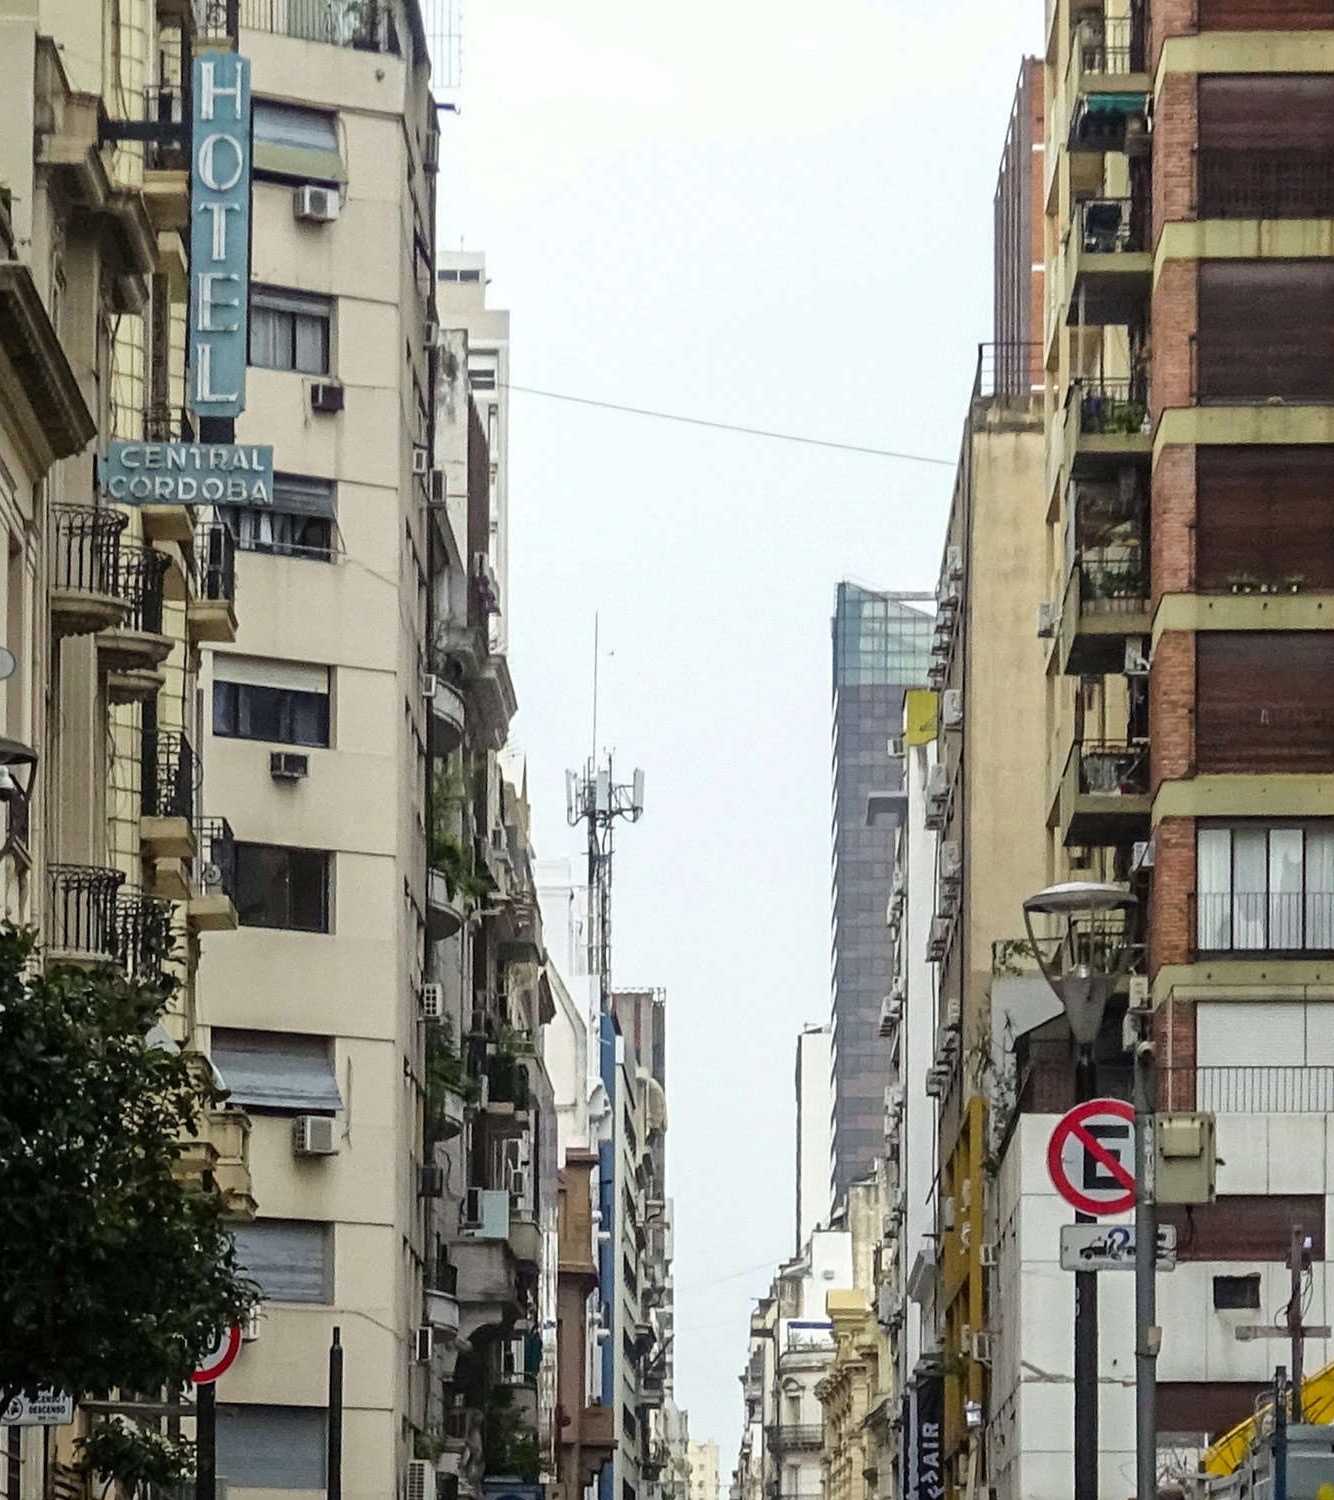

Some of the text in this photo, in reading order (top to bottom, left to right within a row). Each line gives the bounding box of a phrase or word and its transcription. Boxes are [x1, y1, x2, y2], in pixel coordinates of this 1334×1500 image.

[197, 60, 243, 402] HOTEL
[120, 446, 266, 471] CENTRAL
[108, 475, 269, 503] CORDOBA
